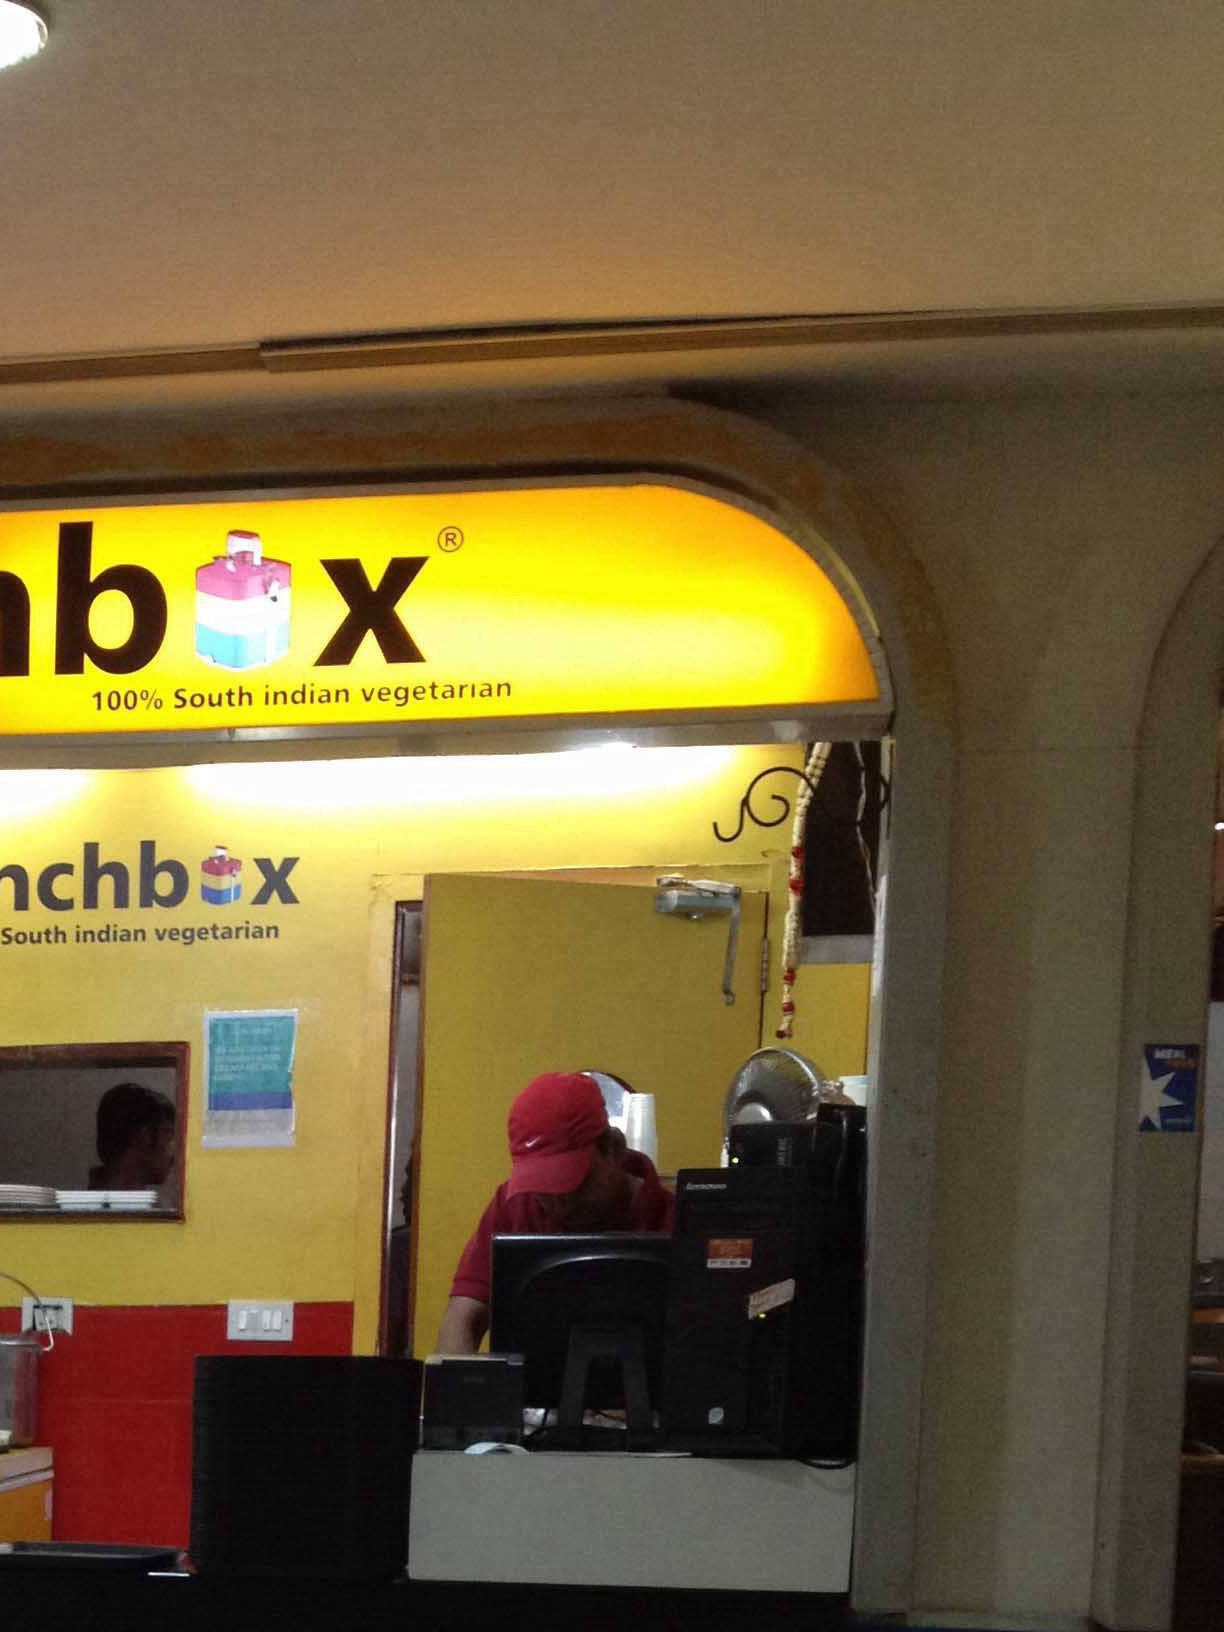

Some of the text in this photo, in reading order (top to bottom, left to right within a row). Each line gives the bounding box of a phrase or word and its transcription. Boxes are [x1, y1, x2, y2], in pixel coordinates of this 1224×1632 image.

[91, 681, 512, 712] 100% South indian vegetarian
[1, 925, 68, 945] South
[75, 924, 147, 943] indian
[154, 921, 280, 944] vegetarian
